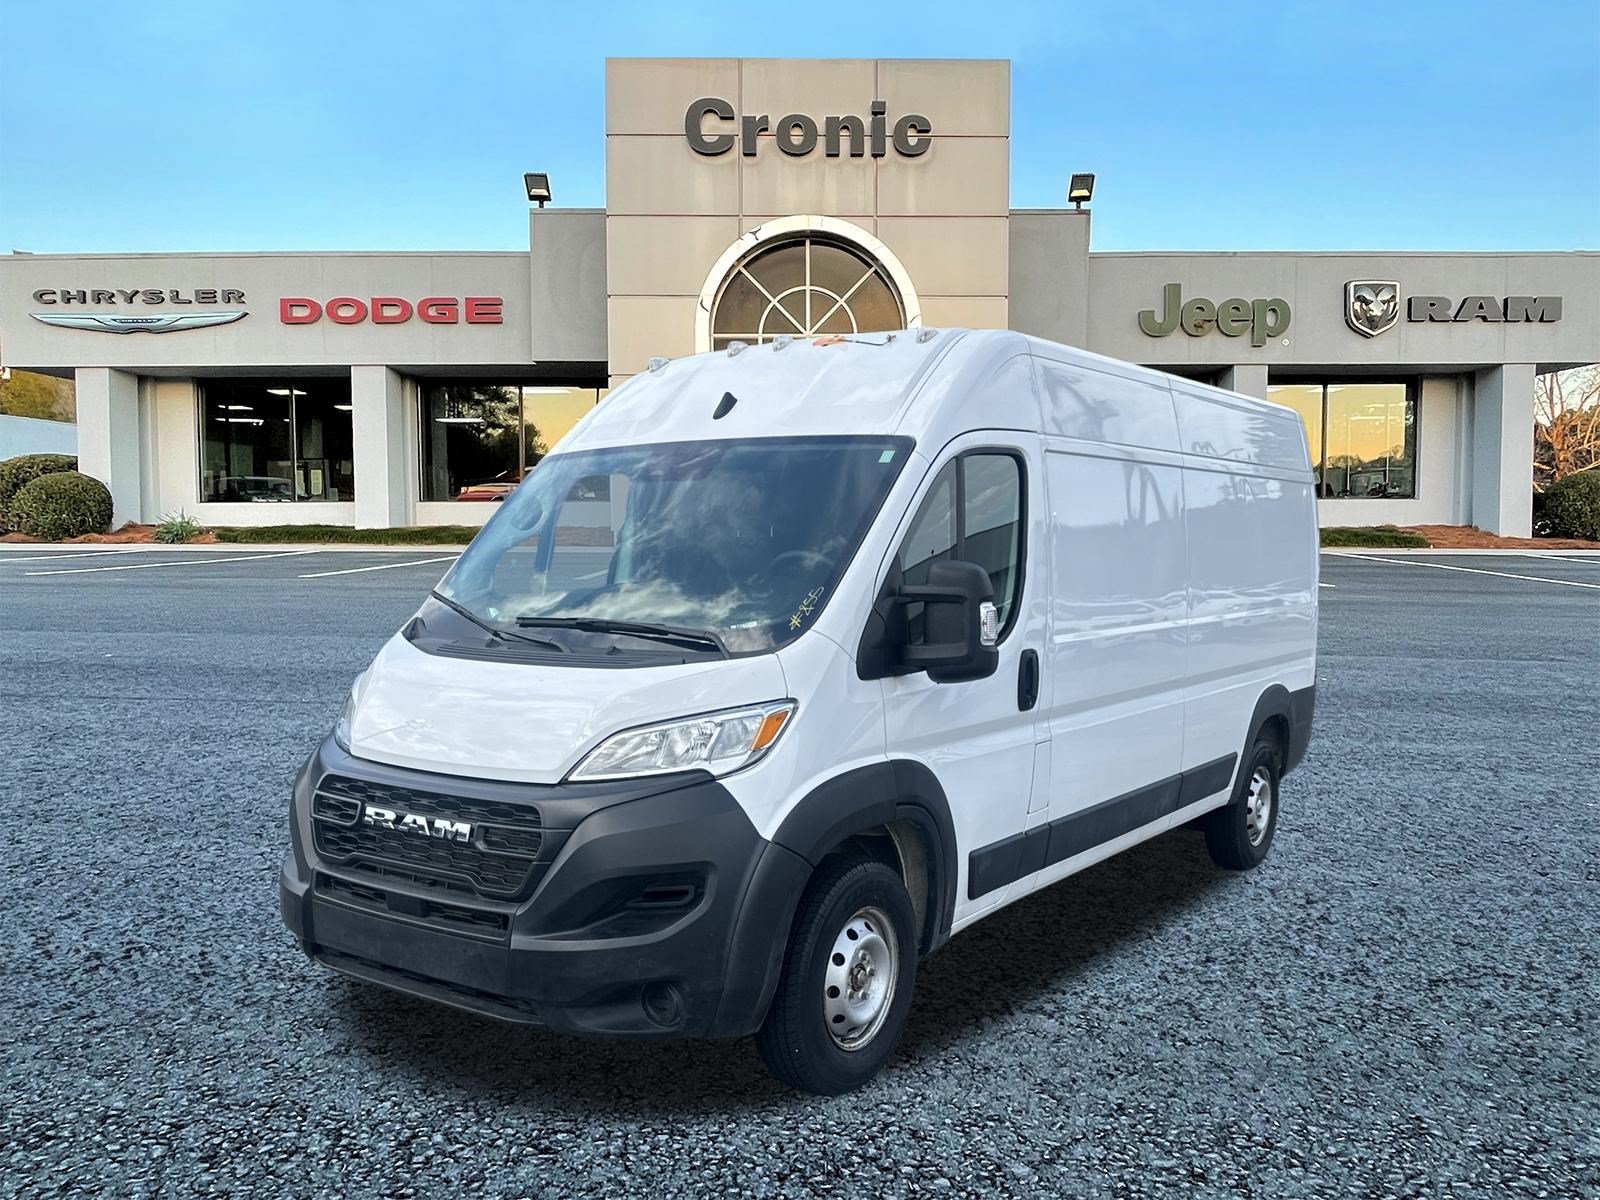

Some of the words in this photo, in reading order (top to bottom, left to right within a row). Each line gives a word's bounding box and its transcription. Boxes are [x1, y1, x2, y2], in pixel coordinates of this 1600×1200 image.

[685, 97, 932, 157] Cronic
[32, 289, 246, 304] CHRYSLER
[280, 297, 503, 324] DODGE
[1407, 296, 1563, 322] RAM
[1138, 283, 1291, 347] Jeep
[363, 806, 472, 843] RAM
